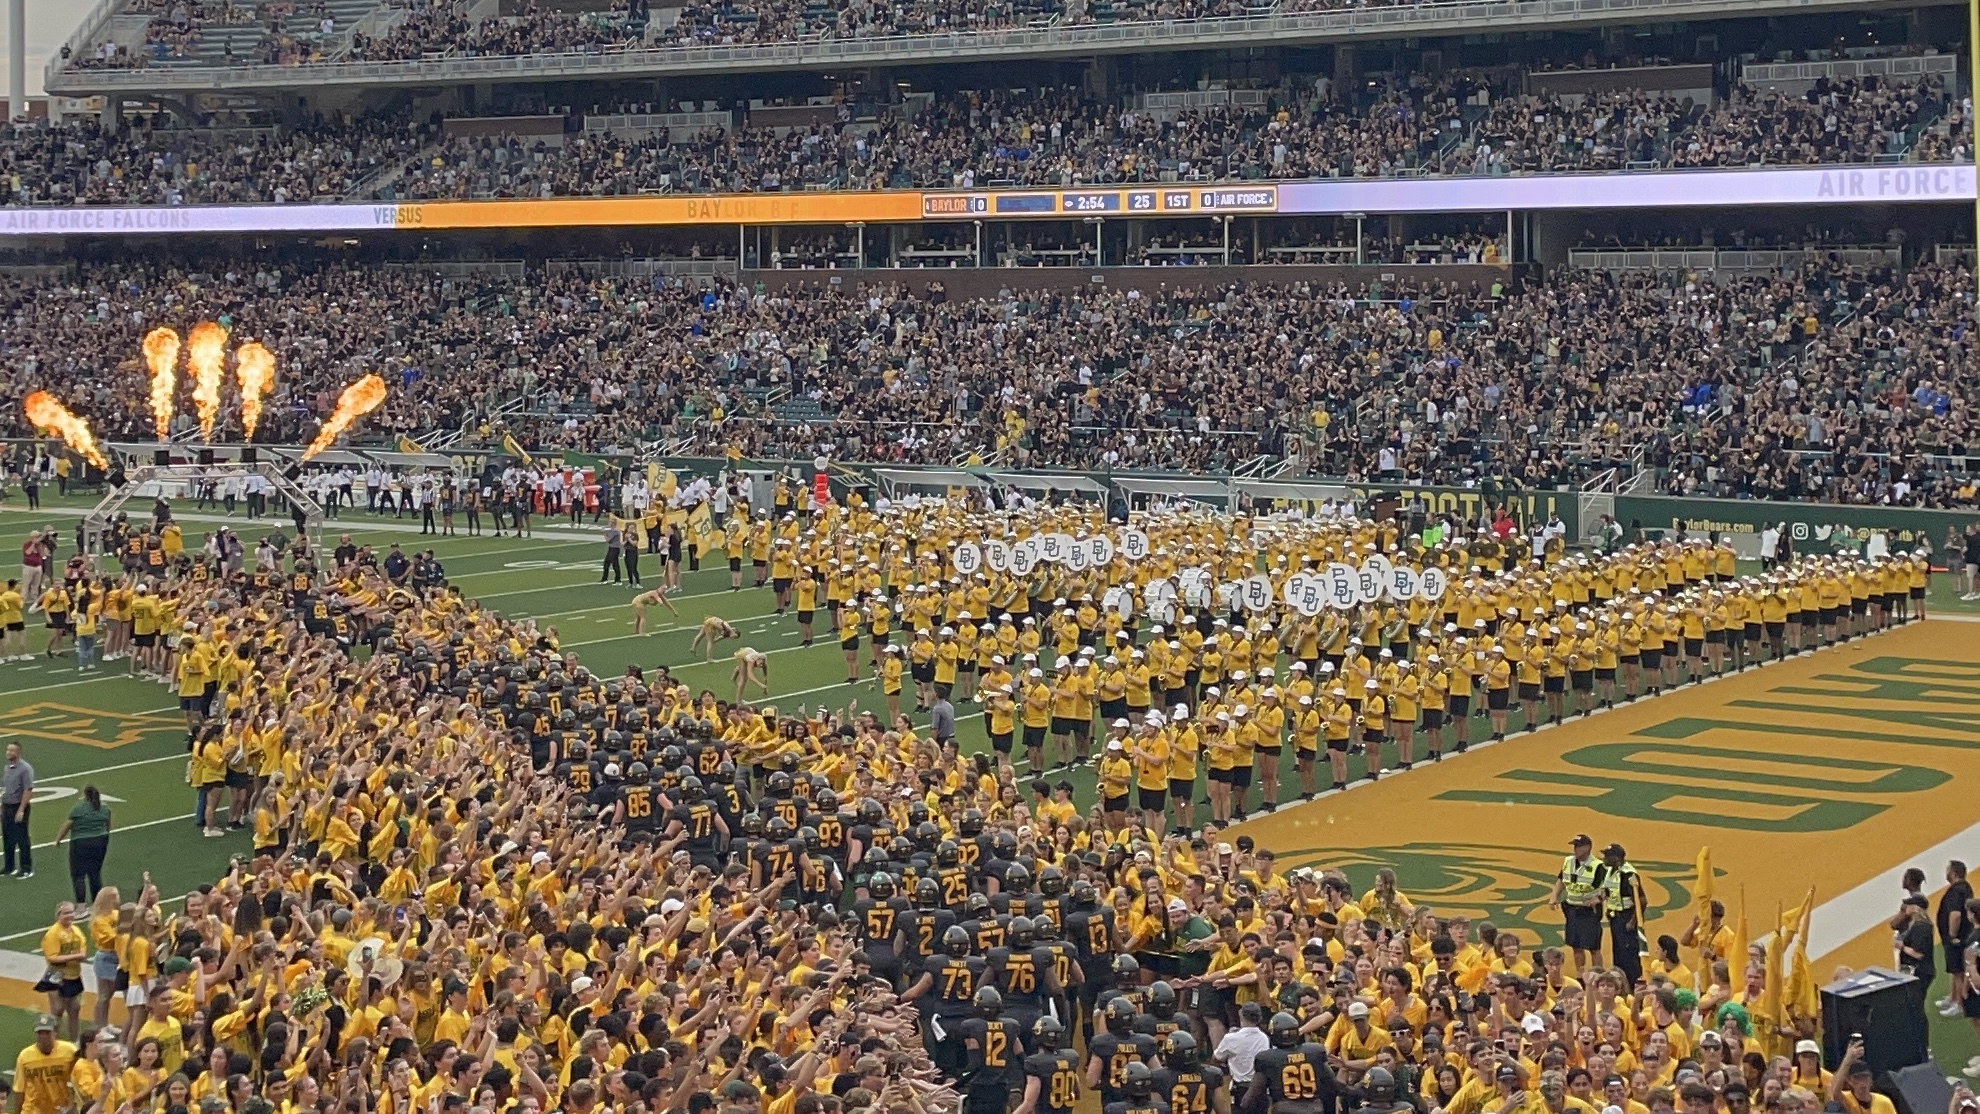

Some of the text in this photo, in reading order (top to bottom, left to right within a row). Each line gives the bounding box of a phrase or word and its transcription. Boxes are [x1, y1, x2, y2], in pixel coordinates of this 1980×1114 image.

[1817, 168, 1967, 197] AIR FORCE
[932, 199, 967, 212] BAYLOR
[977, 200, 985, 211] 0
[1077, 196, 1105, 210] 2:54
[1134, 195, 1150, 209] 25
[1167, 195, 1189, 208] 1ST
[1220, 193, 1268, 205] AIR FORCE
[7, 209, 190, 229] AIR FORCE FALCONS
[373, 207, 422, 224] VERSUS
[627, 792, 652, 819] 85
[690, 810, 712, 839] 77
[818, 821, 842, 849] 93
[941, 873, 969, 906] 25
[867, 908, 896, 940] 57
[918, 924, 934, 956] 2
[941, 967, 972, 1000] 73
[1005, 962, 1036, 994] 76
[985, 1031, 1008, 1067] 12
[1050, 1070, 1076, 1110] 80
[1281, 1062, 1317, 1099] 69
